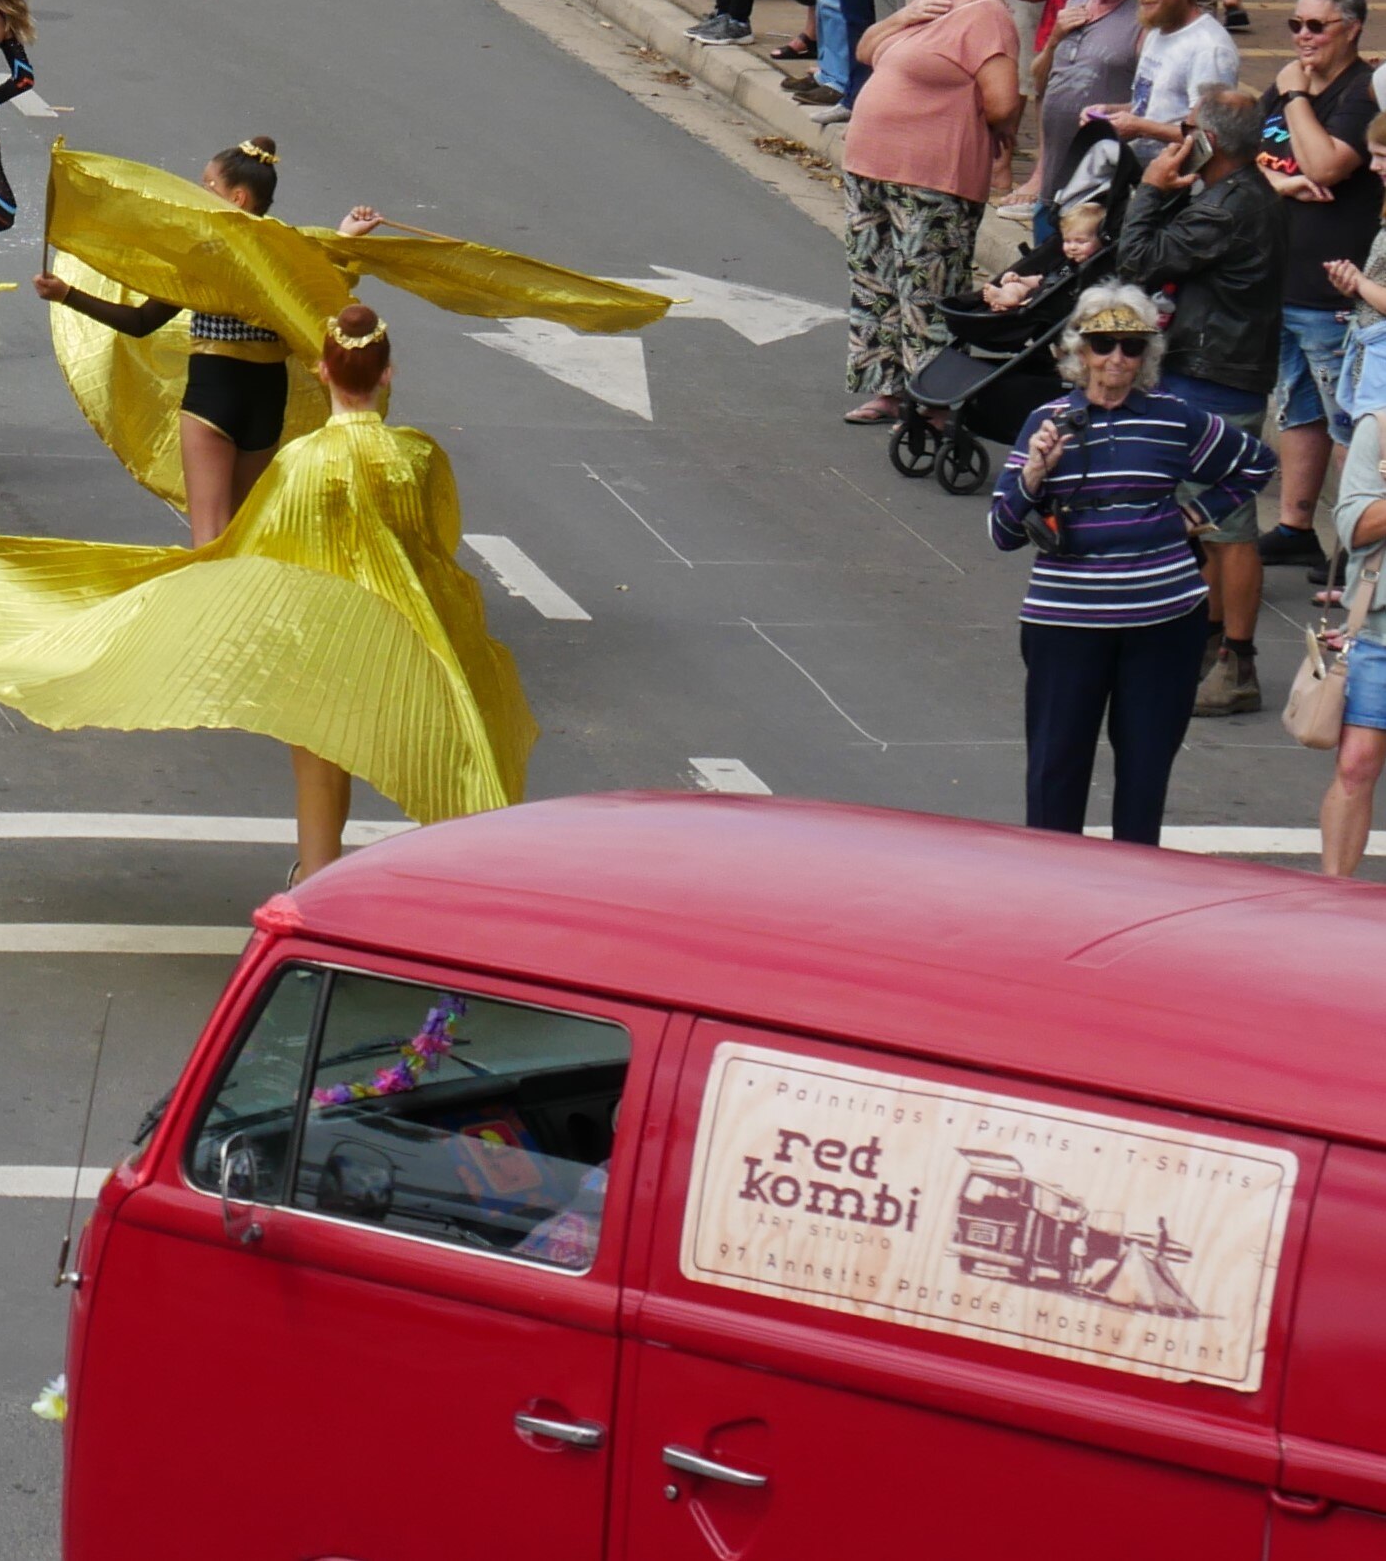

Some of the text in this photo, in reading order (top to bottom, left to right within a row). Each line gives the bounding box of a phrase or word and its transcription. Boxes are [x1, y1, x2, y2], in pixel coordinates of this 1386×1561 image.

[774, 1128, 882, 1180] red
[1126, 1149, 1252, 1189] T-Shirts
[738, 1155, 922, 1233] kombi
[757, 1212, 891, 1250] ART STUDIO
[719, 1242, 747, 1262] 97
[766, 1252, 877, 1288] Annetts
[1035, 1309, 1122, 1345] Mossy
[1143, 1332, 1225, 1362] Point
